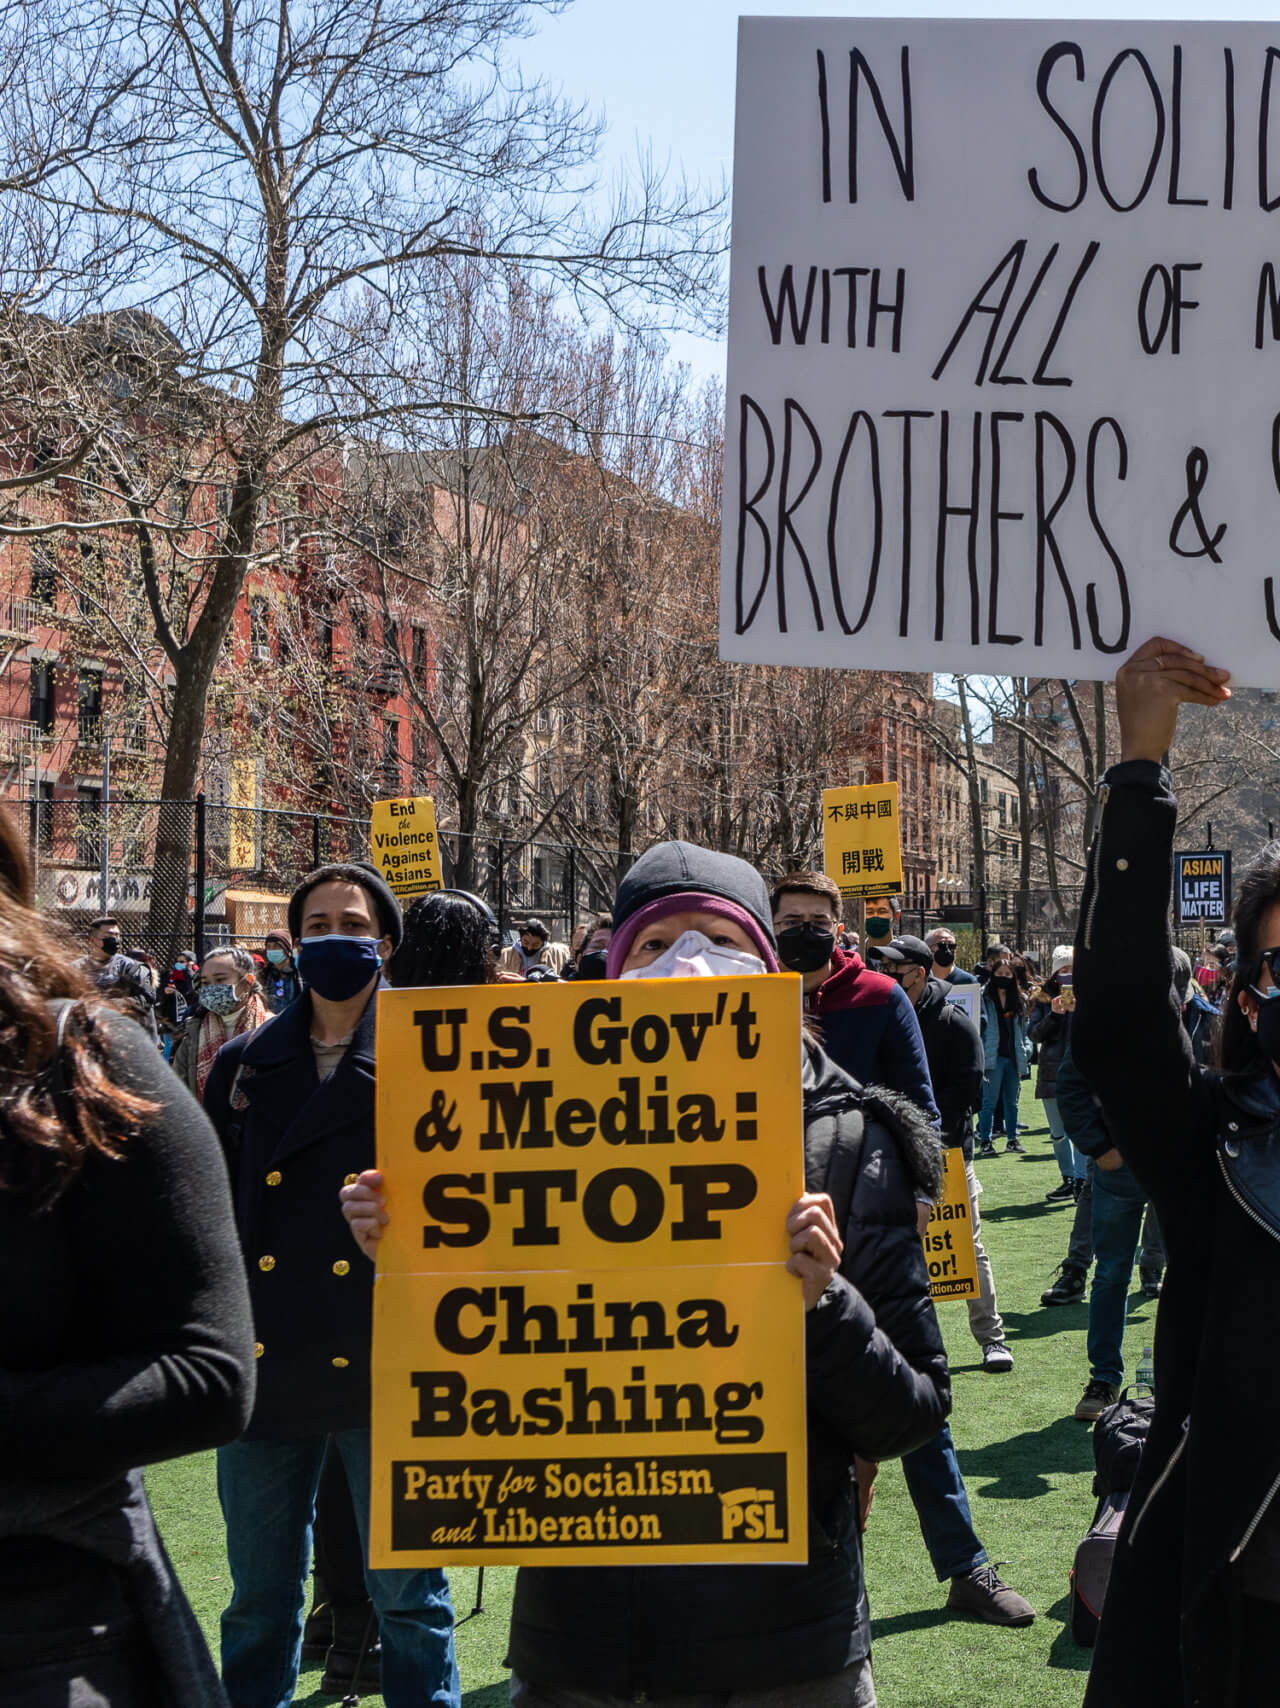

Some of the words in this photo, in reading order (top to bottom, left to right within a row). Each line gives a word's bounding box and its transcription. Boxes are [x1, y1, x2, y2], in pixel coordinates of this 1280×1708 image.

[817, 46, 914, 204] IN
[758, 265, 905, 353] WITH
[932, 240, 1100, 387] ALL
[1138, 263, 1202, 355] OF
[736, 394, 1130, 655] BROTHERS
[1169, 447, 1227, 563] &
[390, 802, 415, 816] End
[828, 799, 892, 823] 不與中國
[398, 818, 410, 829] the
[375, 831, 434, 848] Violence
[382, 849, 432, 868] Against
[842, 848, 884, 875] 開戰
[1183, 860, 1222, 876] ASIAN
[386, 868, 432, 882] Asians
[1184, 881, 1220, 899] LIFE
[1181, 900, 1223, 917] MATTER
[414, 1006, 550, 1072] U.S.
[573, 992, 760, 1065] Gov't
[414, 1090, 462, 1152] &
[480, 1076, 758, 1150] Media:
[423, 1163, 758, 1248] STOP
[928, 1203, 966, 1222] sian
[929, 1254, 957, 1277] or!
[931, 1280, 971, 1296] ition.org
[434, 1283, 739, 1355] China
[411, 1366, 764, 1445] Bashing
[404, 1466, 492, 1509] Party
[497, 1473, 538, 1502] for
[545, 1462, 714, 1498] Socialism
[431, 1522, 477, 1543] and
[484, 1506, 662, 1542] Liberation
[720, 1500, 784, 1540] PSL
